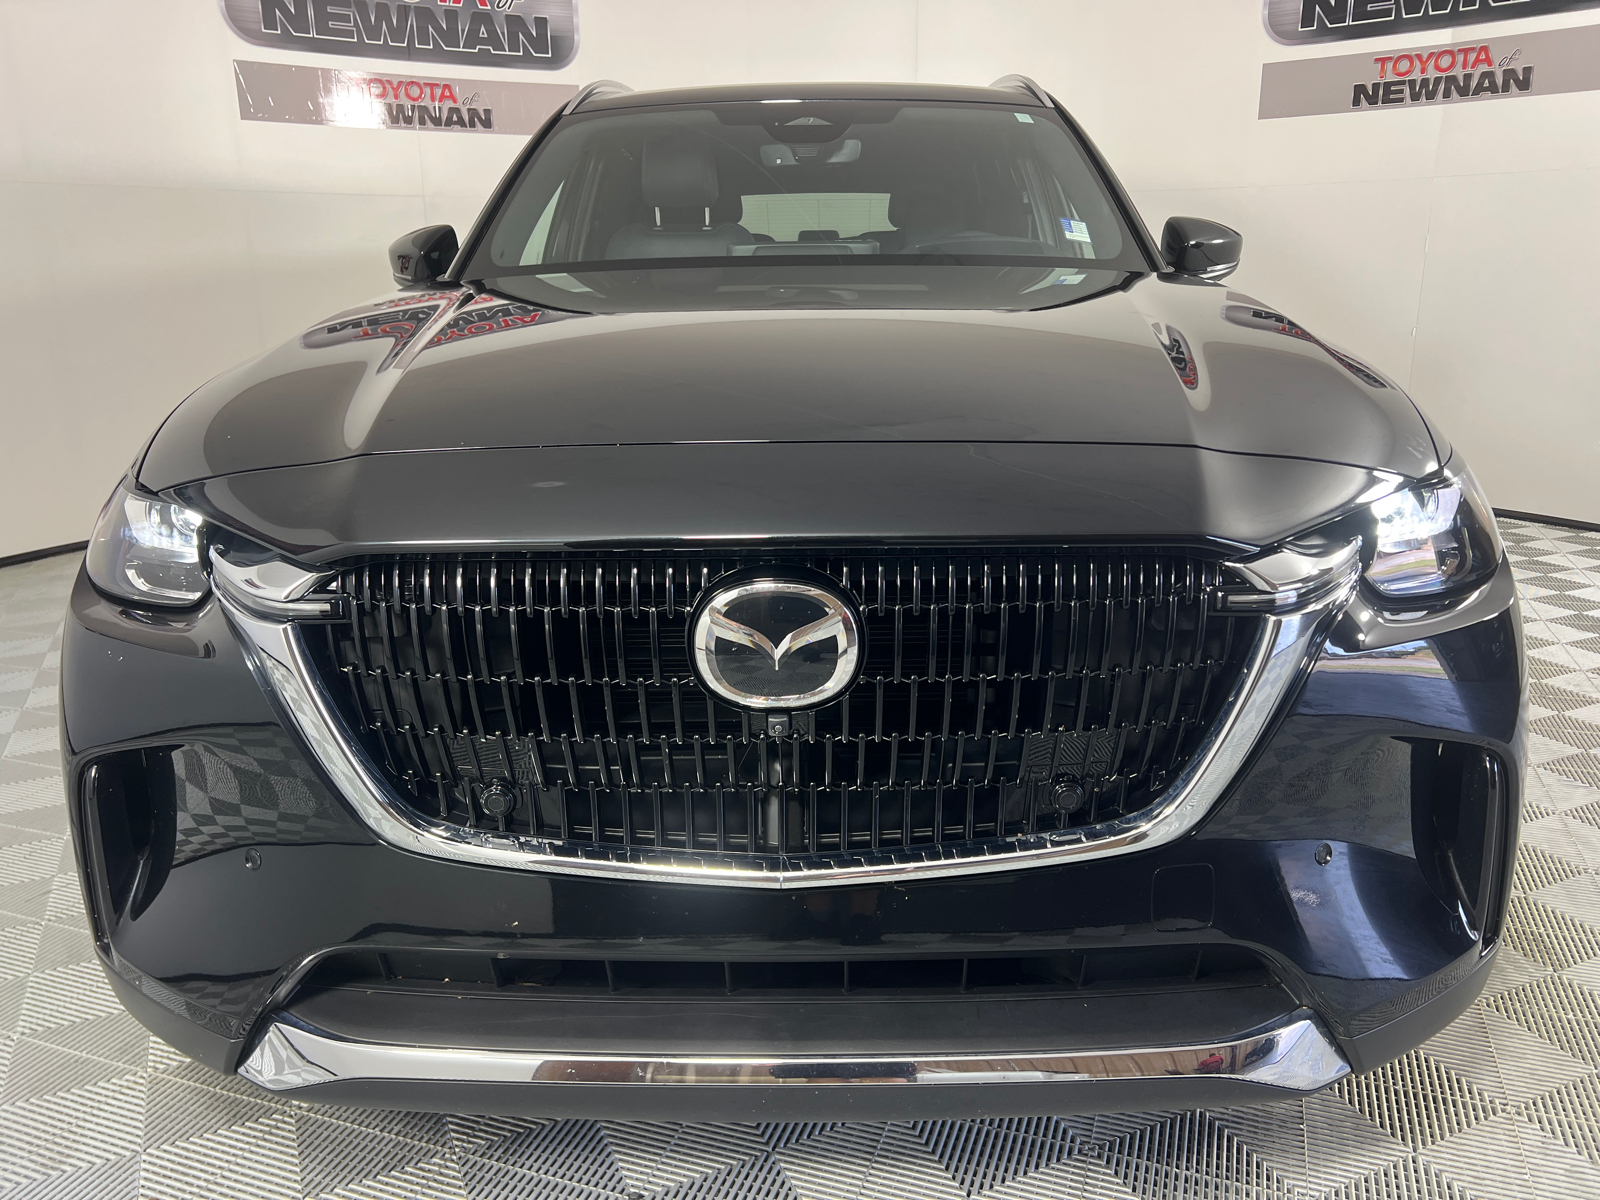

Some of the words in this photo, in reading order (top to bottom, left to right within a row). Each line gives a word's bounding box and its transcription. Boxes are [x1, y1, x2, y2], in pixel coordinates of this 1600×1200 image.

[260, 0, 552, 57] NEWNAN
[1373, 44, 1495, 79] TOYOTA
[1498, 48, 1522, 67] of
[461, 91, 480, 107] of
[1351, 65, 1534, 108] NEWNAN
